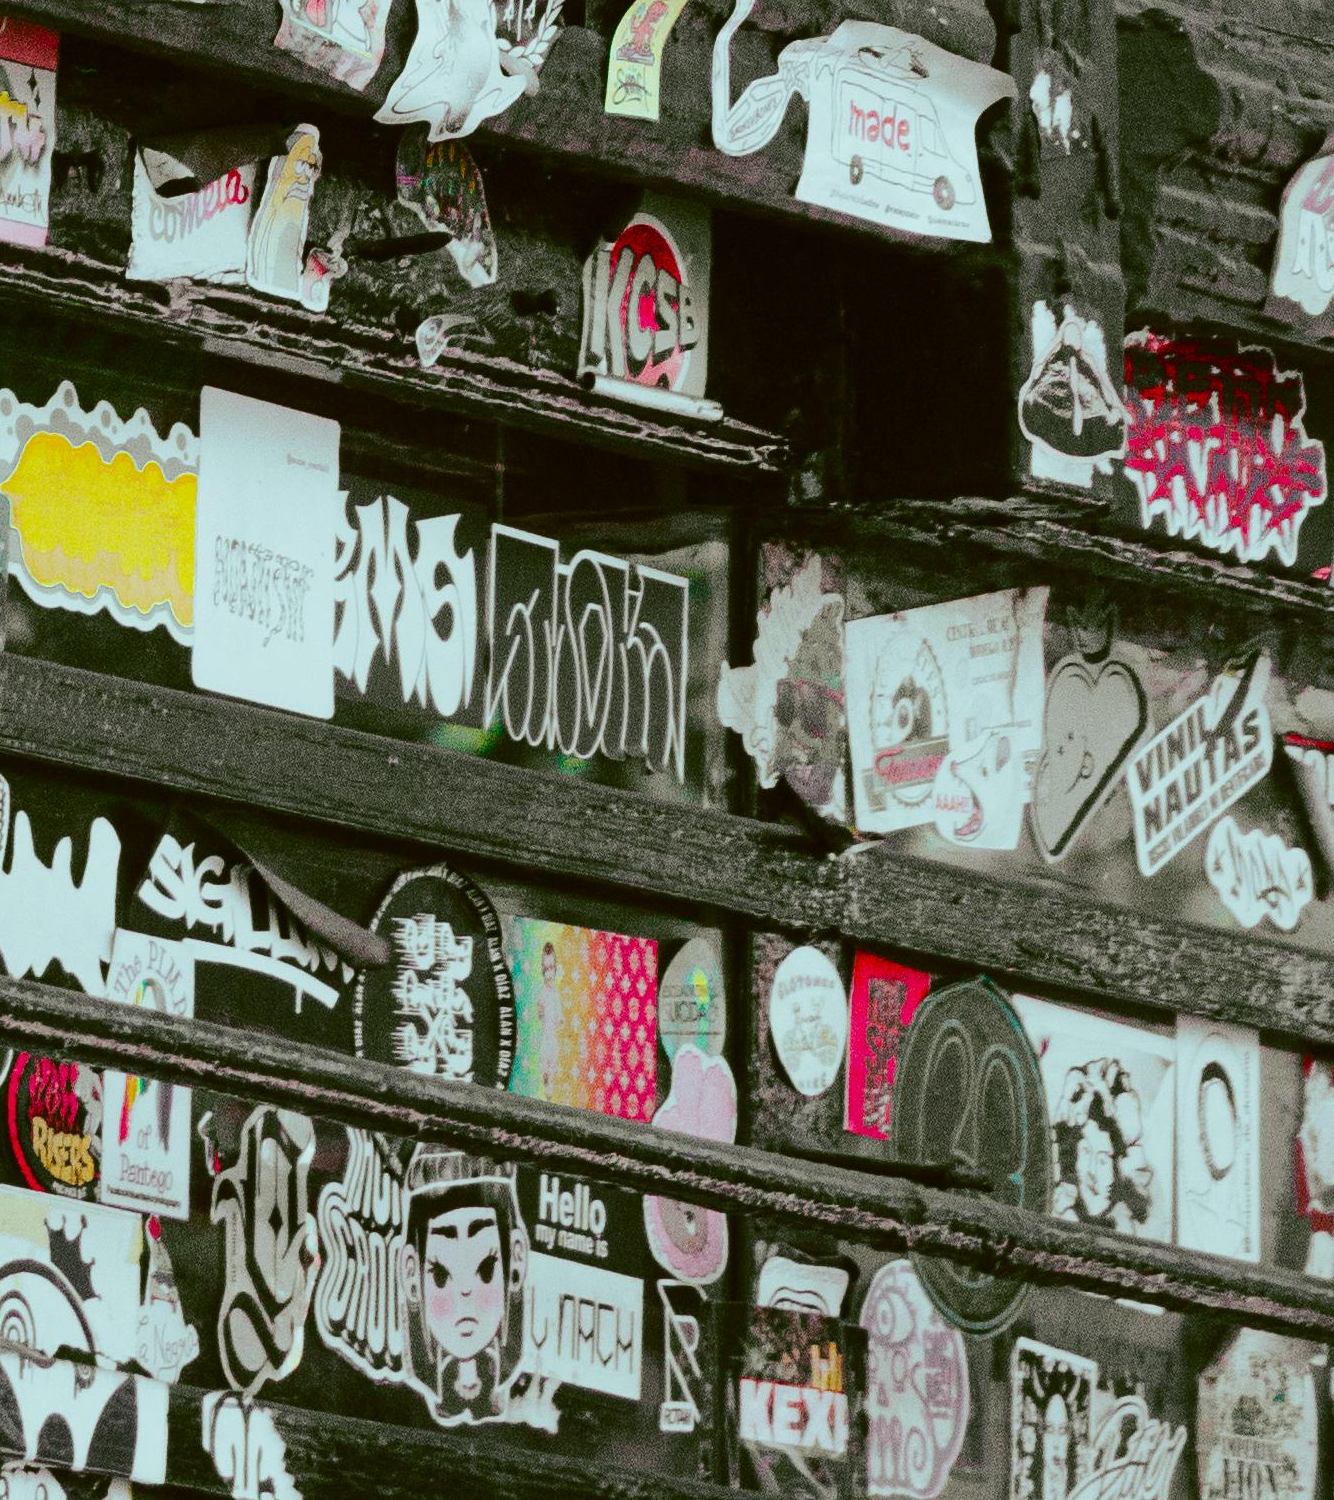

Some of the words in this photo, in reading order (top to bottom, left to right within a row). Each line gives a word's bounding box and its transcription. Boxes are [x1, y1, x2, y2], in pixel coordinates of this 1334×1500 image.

[848, 99, 911, 152] made
[137, 1125, 150, 1151] of
[537, 1173, 607, 1238] Hello
[534, 1222, 555, 1250] my
[556, 1226, 594, 1255] name
[595, 1236, 609, 1258] is
